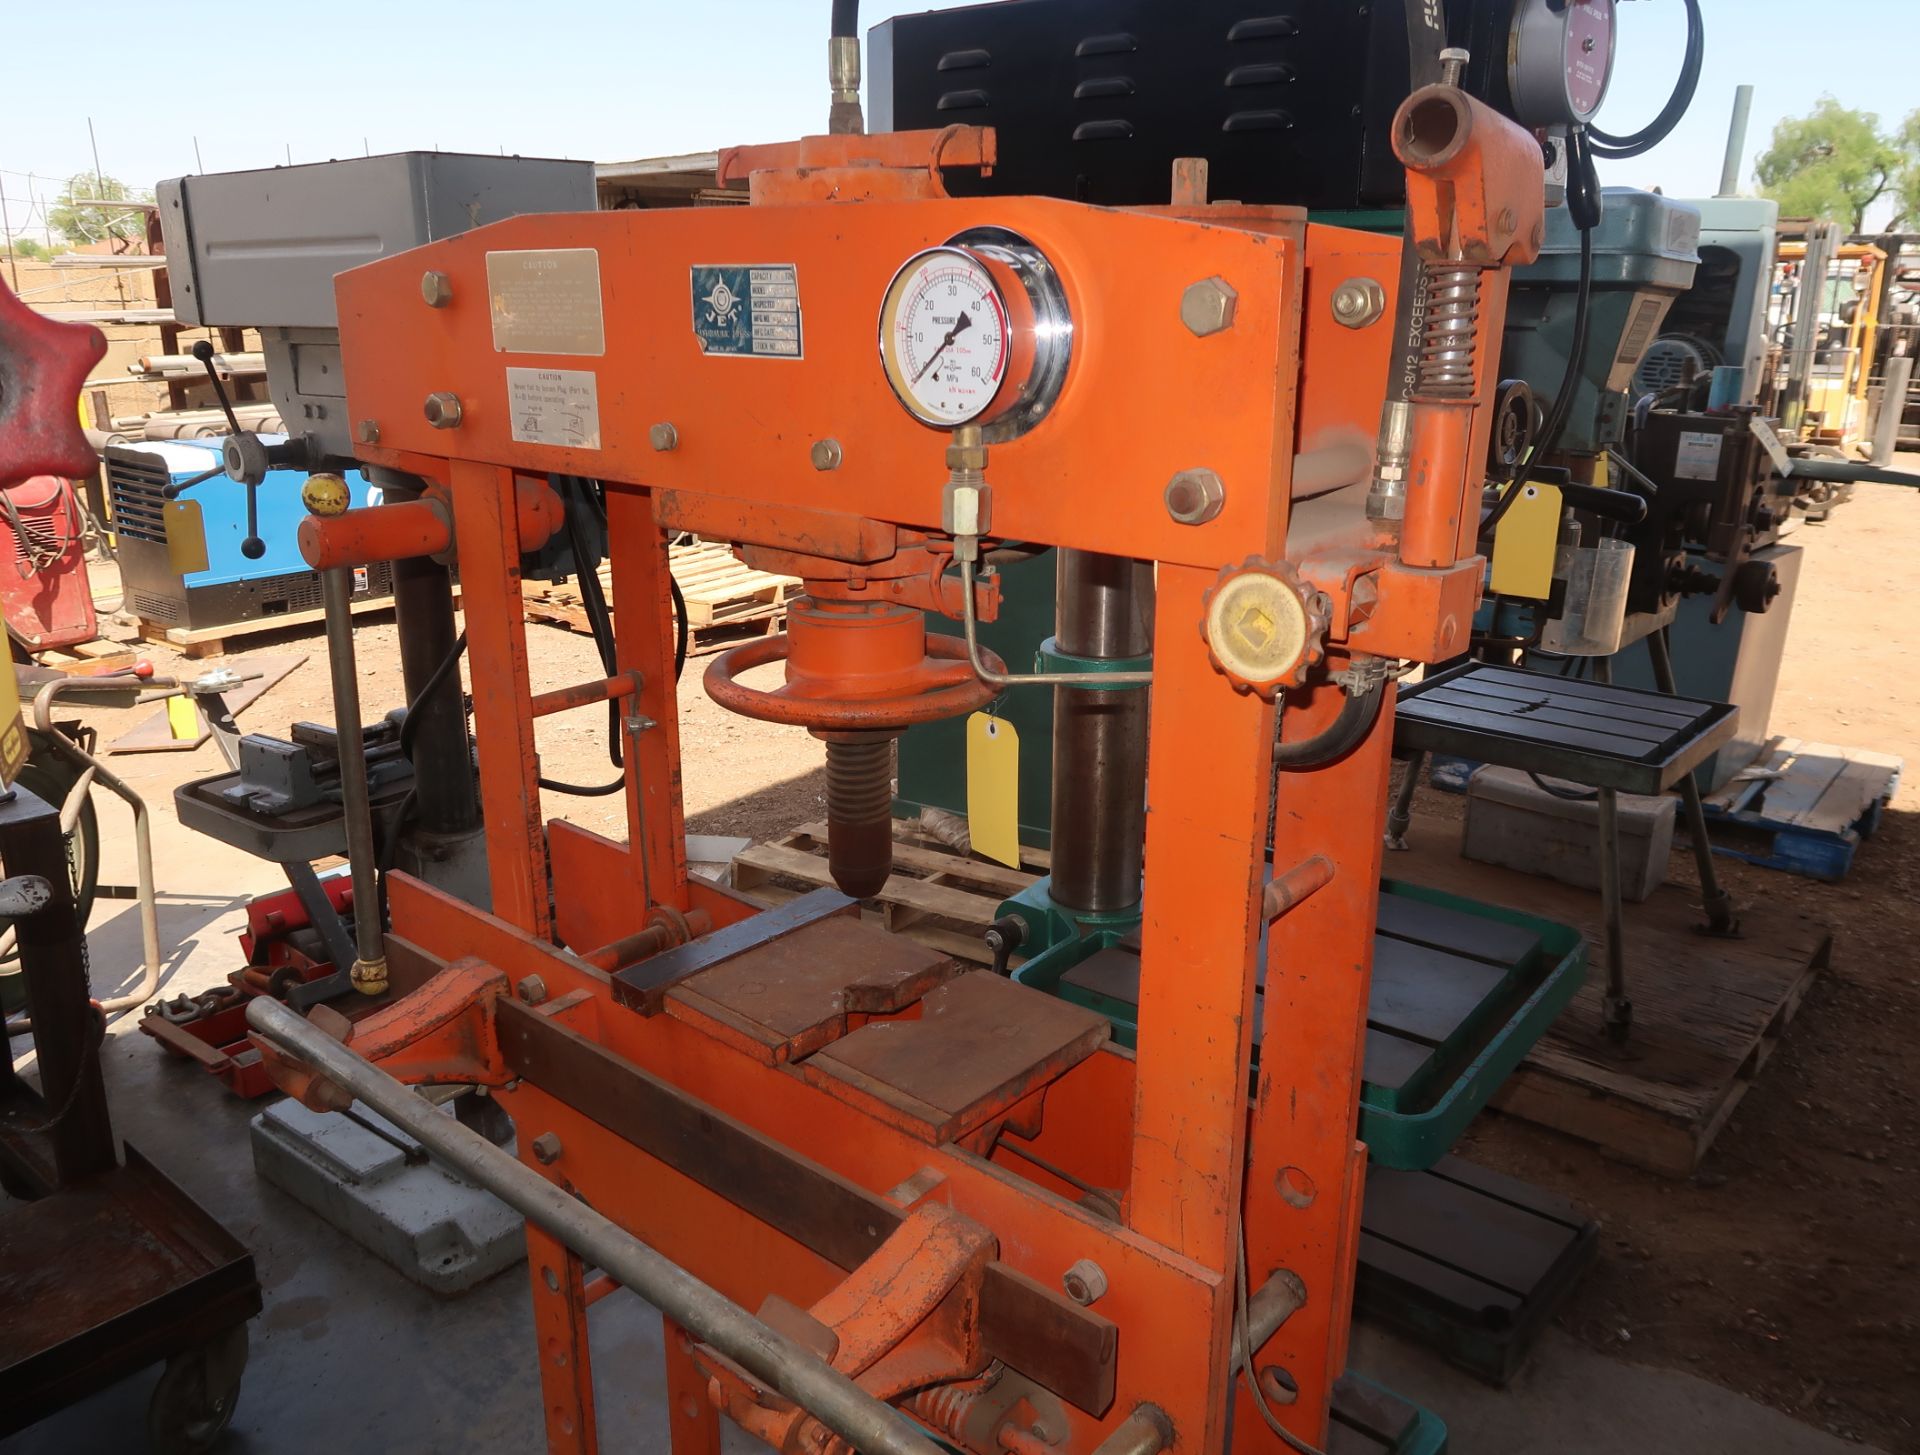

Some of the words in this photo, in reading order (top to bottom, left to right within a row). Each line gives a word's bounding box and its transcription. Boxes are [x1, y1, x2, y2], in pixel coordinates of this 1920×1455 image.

[522, 260, 558, 270] CAUTION
[751, 273, 772, 281] CAPACITY
[752, 287, 766, 295] MODEL
[947, 285, 958, 296] 30
[753, 301, 775, 309] INSPECTED
[924, 300, 934, 311] 20
[971, 301, 981, 312] 40
[706, 308, 737, 326] JET
[932, 316, 956, 325] PRESSURE
[915, 331, 924, 343] 10
[982, 334, 993, 345] 50
[538, 373, 562, 381] CAUTION
[971, 367, 981, 378] 60
[946, 374, 959, 384] MPa
